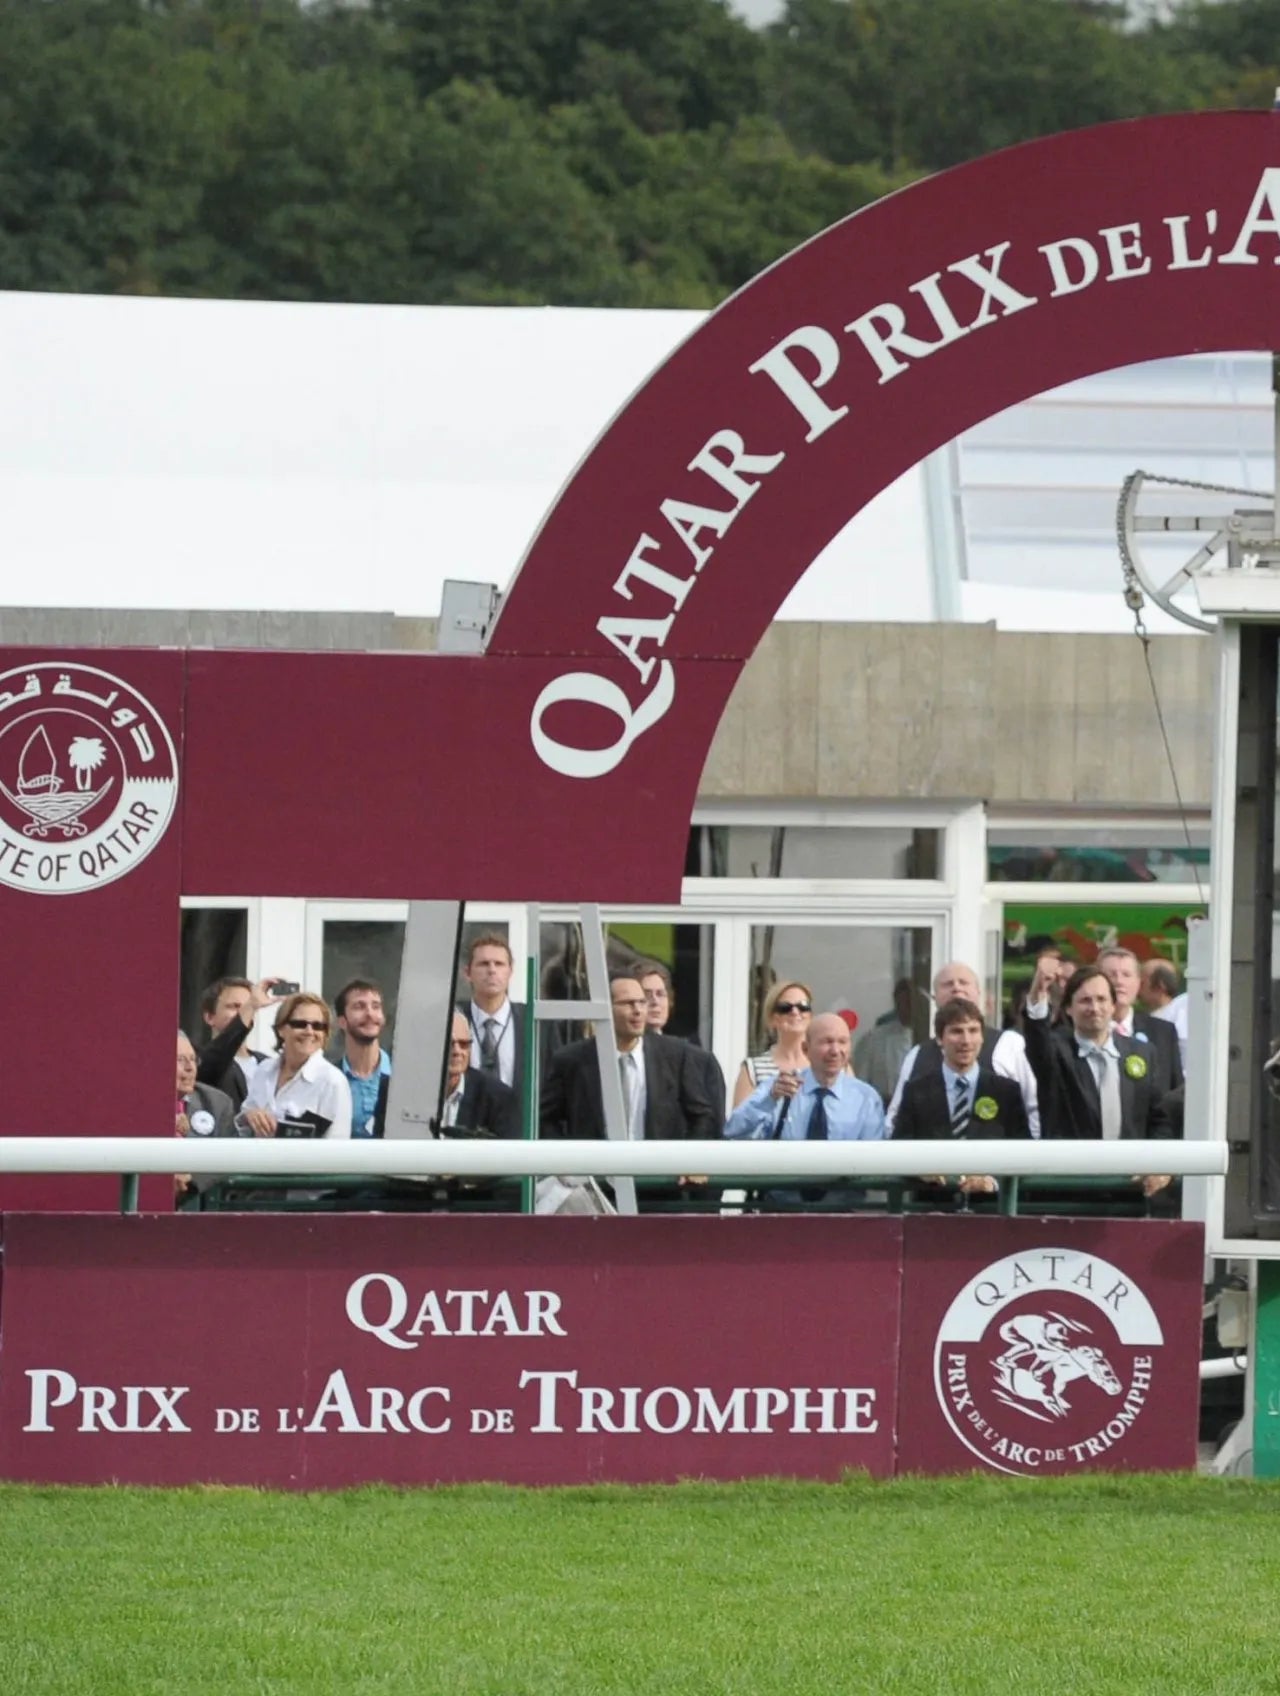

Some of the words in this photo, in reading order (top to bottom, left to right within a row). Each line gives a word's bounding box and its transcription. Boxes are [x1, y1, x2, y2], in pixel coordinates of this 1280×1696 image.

[530, 429, 785, 779] QATAR
[748, 241, 1038, 443] PRIX
[1037, 222, 1151, 298] DE
[38, 854, 71, 882] OF
[79, 800, 159, 877] QATAR
[345, 1272, 568, 1350] QATAR
[974, 1255, 1129, 1311] QATAR
[22, 1368, 192, 1433] PRIX
[214, 1408, 261, 1433] DE
[469, 1408, 515, 1433] DE
[518, 1369, 879, 1434] TRIOMPHE
[948, 1353, 974, 1412] PRIX
[967, 1410, 987, 1431] DE
[1044, 1448, 1065, 1461] DE
[1068, 1355, 1152, 1462] TRIOMPHE
